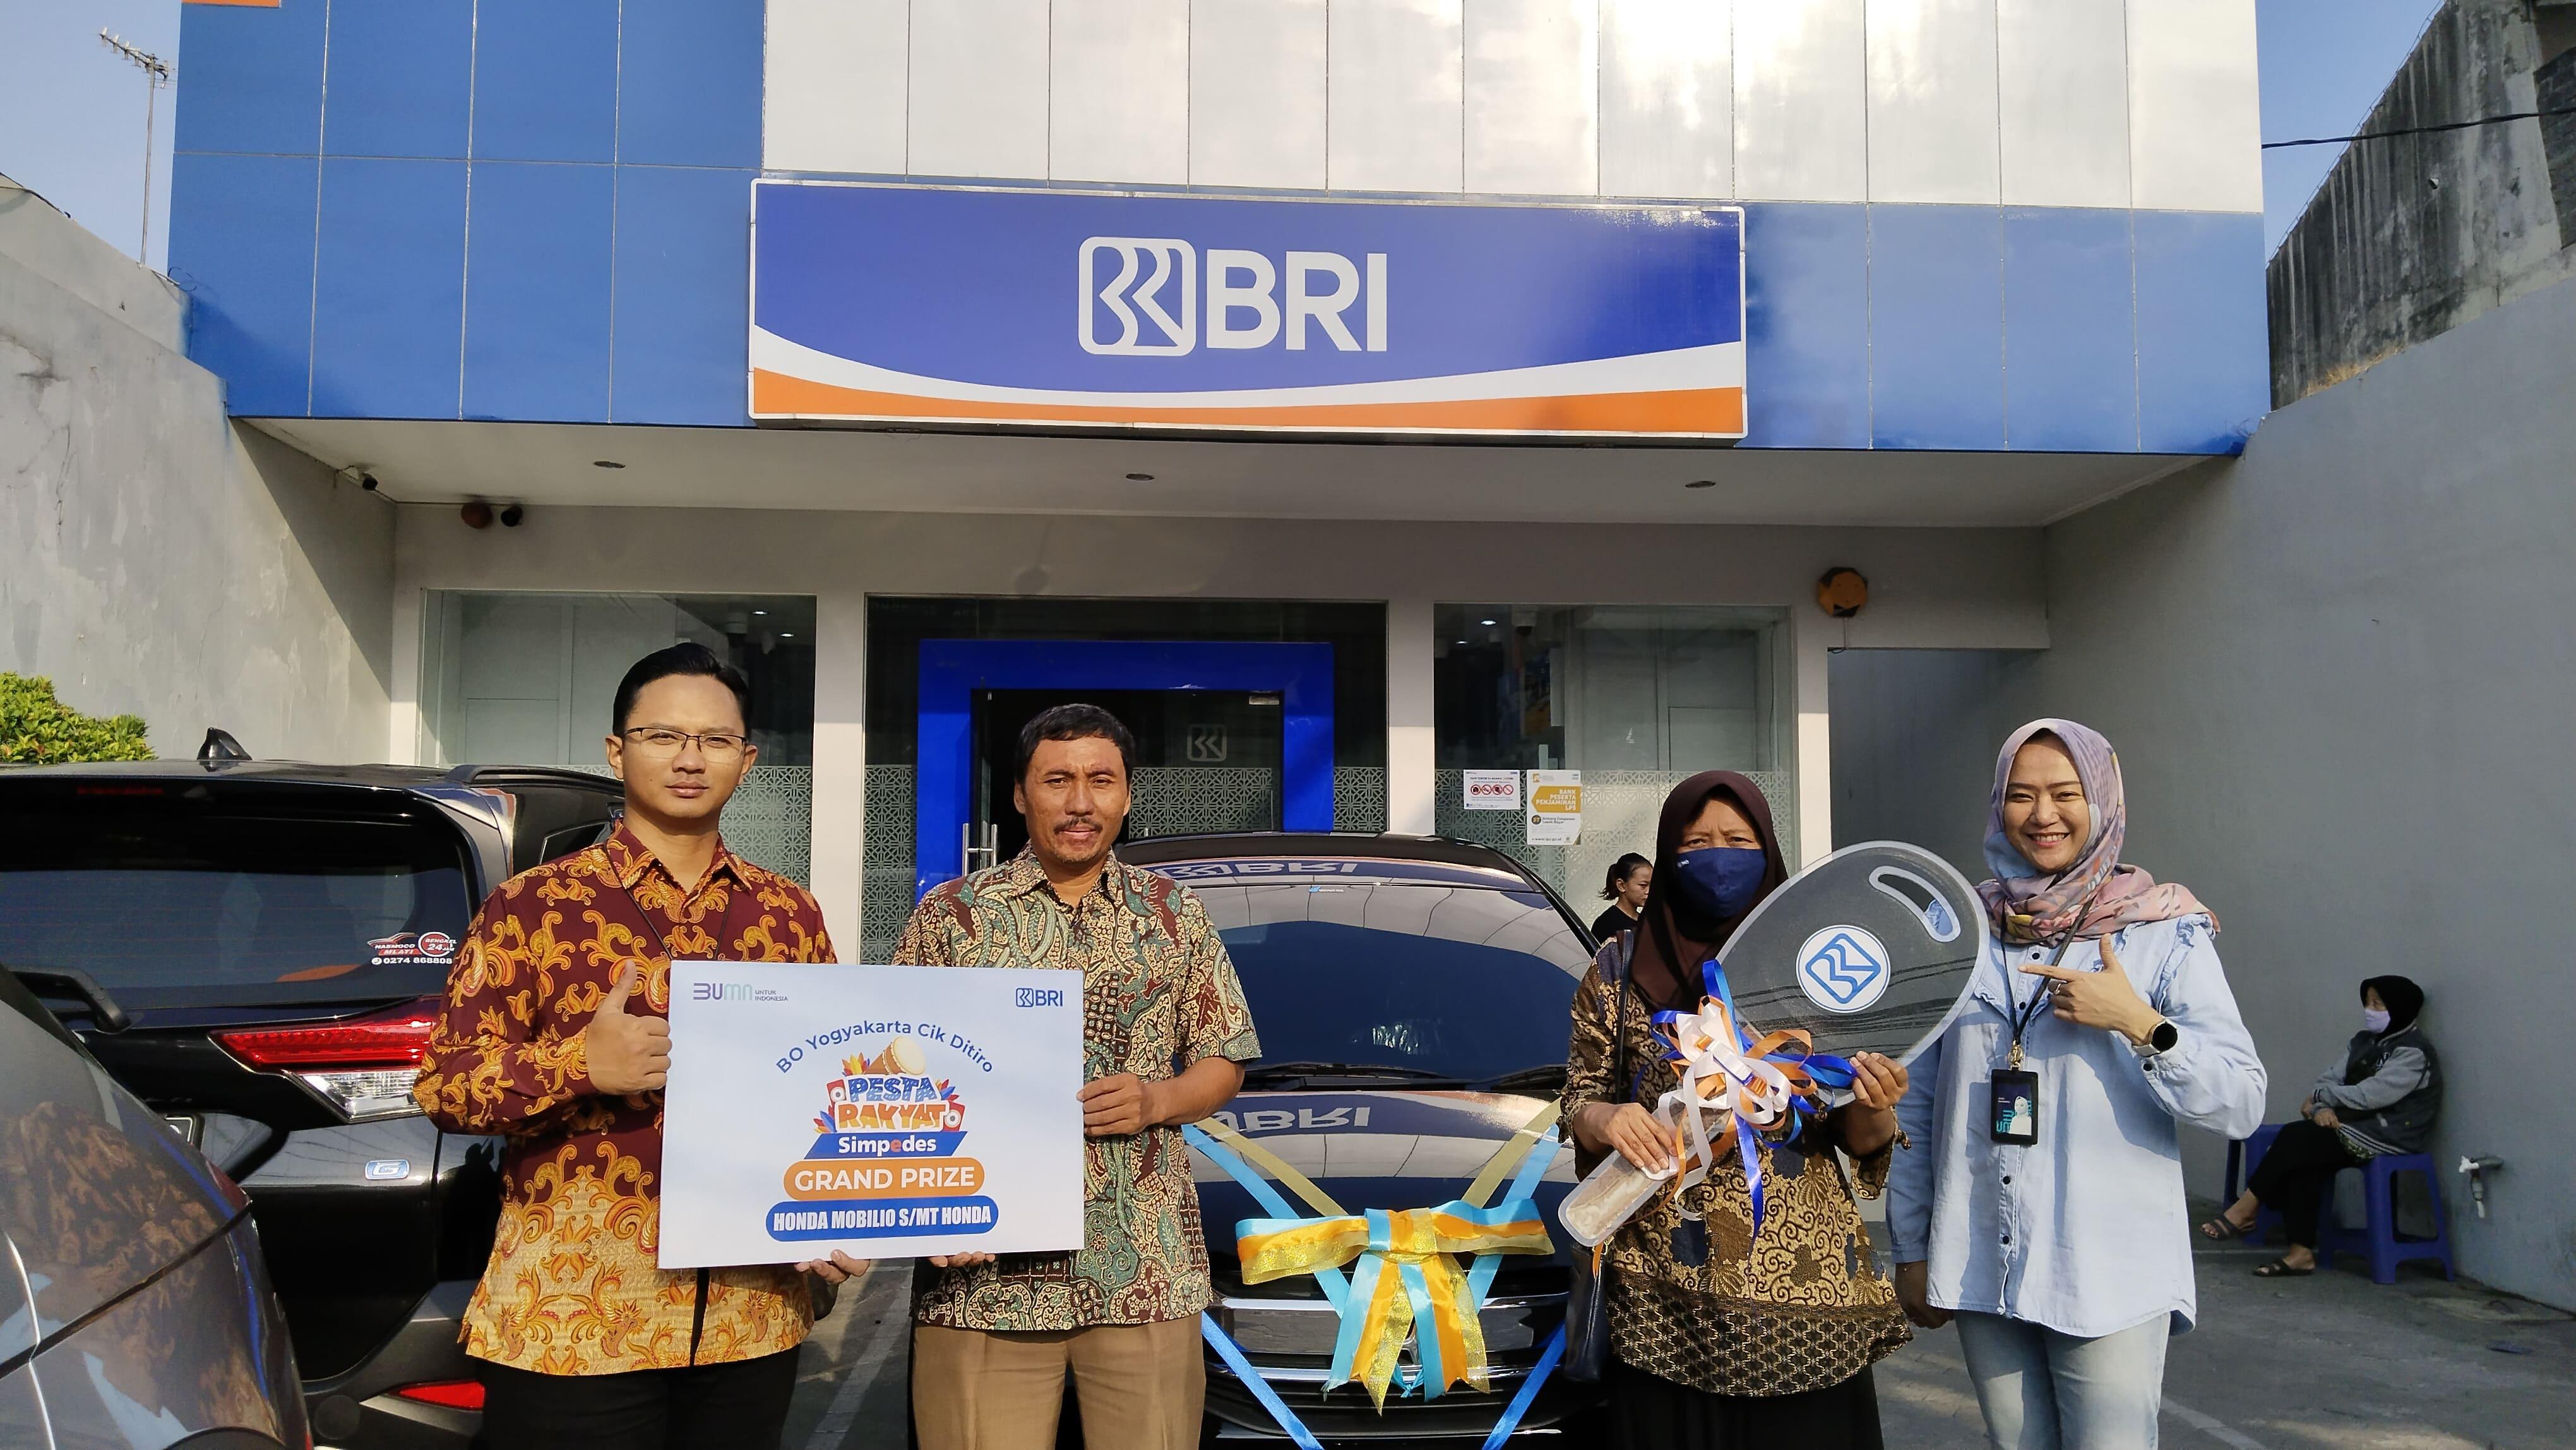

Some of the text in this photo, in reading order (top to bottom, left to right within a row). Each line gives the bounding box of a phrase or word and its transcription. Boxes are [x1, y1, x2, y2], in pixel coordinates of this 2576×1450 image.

[1207, 249, 1387, 352] BRI
[1035, 990, 1063, 1006] BRI
[776, 1021, 993, 1073] BO Yogyakarta Cik Ditiro
[848, 1077, 937, 1102] PESTA
[838, 1103, 946, 1129] RAKYAT
[838, 1135, 936, 1156] Simpedes
[794, 1166, 975, 1191] GRAND PRIZE
[773, 1206, 991, 1231] HONDA MOBILIO S/MT HONDA
